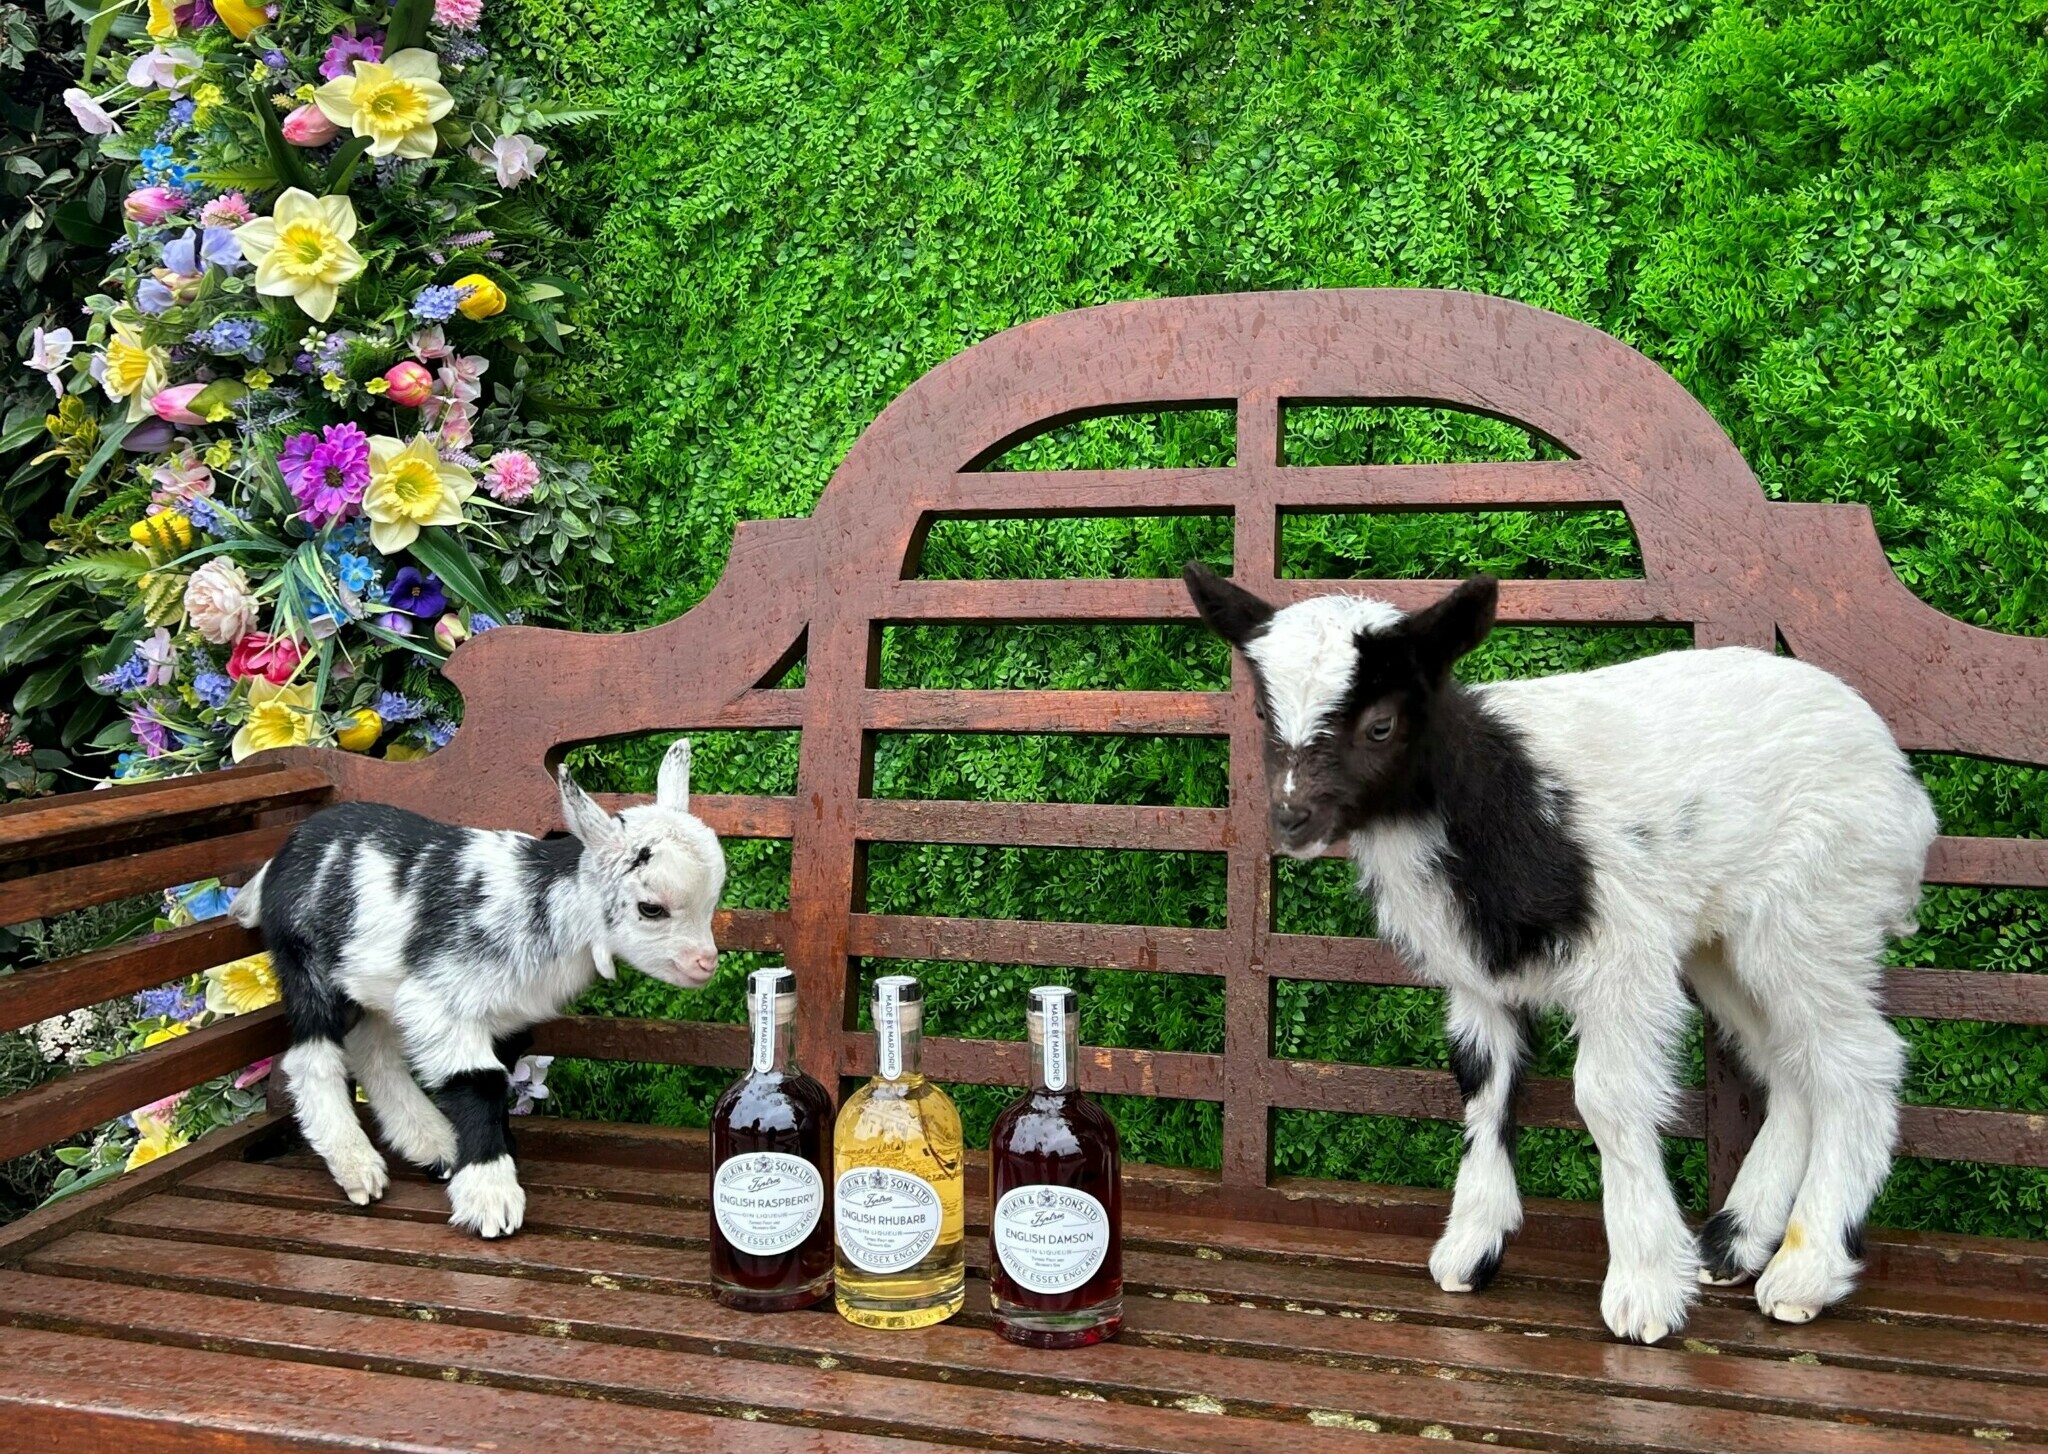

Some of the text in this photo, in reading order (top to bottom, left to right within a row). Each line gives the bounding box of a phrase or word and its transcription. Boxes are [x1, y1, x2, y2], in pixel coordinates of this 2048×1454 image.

[761, 1016, 769, 1026] BY
[885, 994, 896, 1071] MADE BY MARJORIE
[1051, 1003, 1060, 1082] MADE BY MARJORIE
[721, 1162, 813, 1184] WILKIN & SONS LTD
[720, 1192, 815, 1208] ENGLISH RASPBERRY
[861, 1176, 867, 1185] &
[890, 1179, 915, 1193] SONS
[915, 1188, 930, 1204] LTD
[841, 1208, 926, 1226] ENGLISH RHUBARB
[1001, 1195, 1098, 1221] WILKIN & SONS LTD
[721, 1211, 813, 1246] TIPTREE ESSEX ENGLAND
[1005, 1228, 1094, 1245] ENGLISH DAMSON
[839, 1224, 930, 1264] TIPTREE ESSEX ENGLAND
[1002, 1247, 1098, 1284] TIPTREE ESSEX ENGLAND
